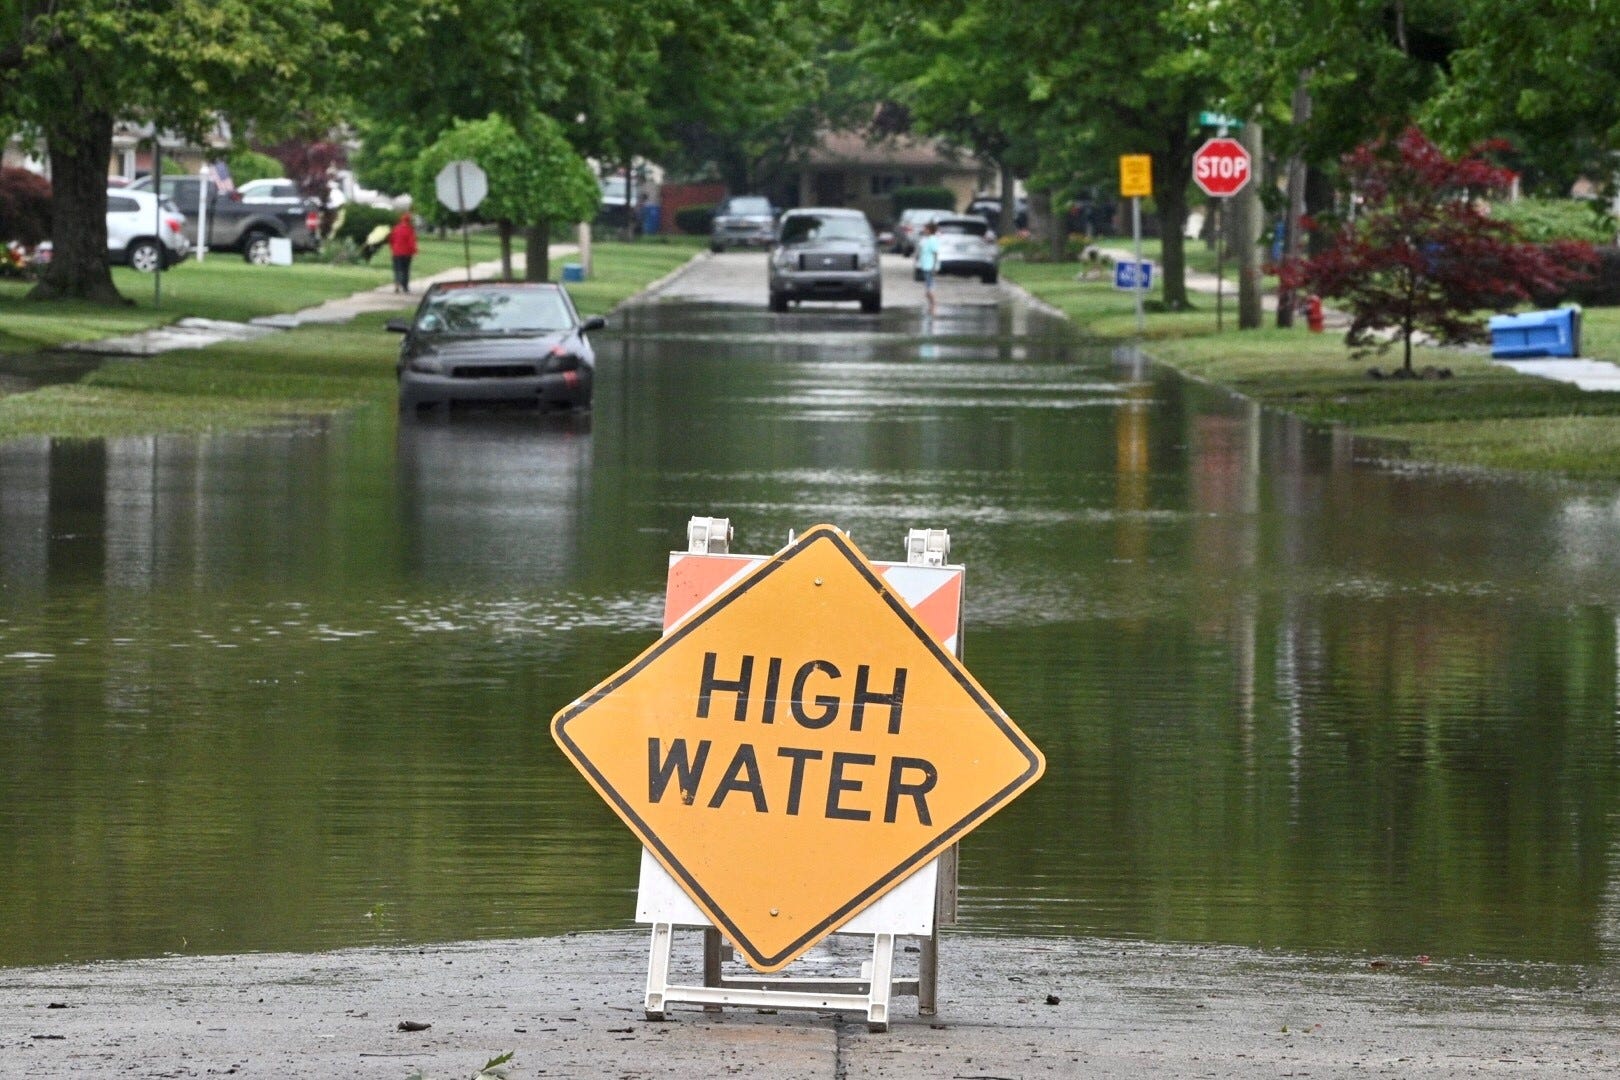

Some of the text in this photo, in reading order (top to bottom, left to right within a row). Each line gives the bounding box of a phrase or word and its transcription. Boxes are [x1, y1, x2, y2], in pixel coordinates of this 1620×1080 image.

[1198, 156, 1247, 179] STOP
[696, 652, 908, 735] HIGH
[647, 737, 938, 827] WATER
